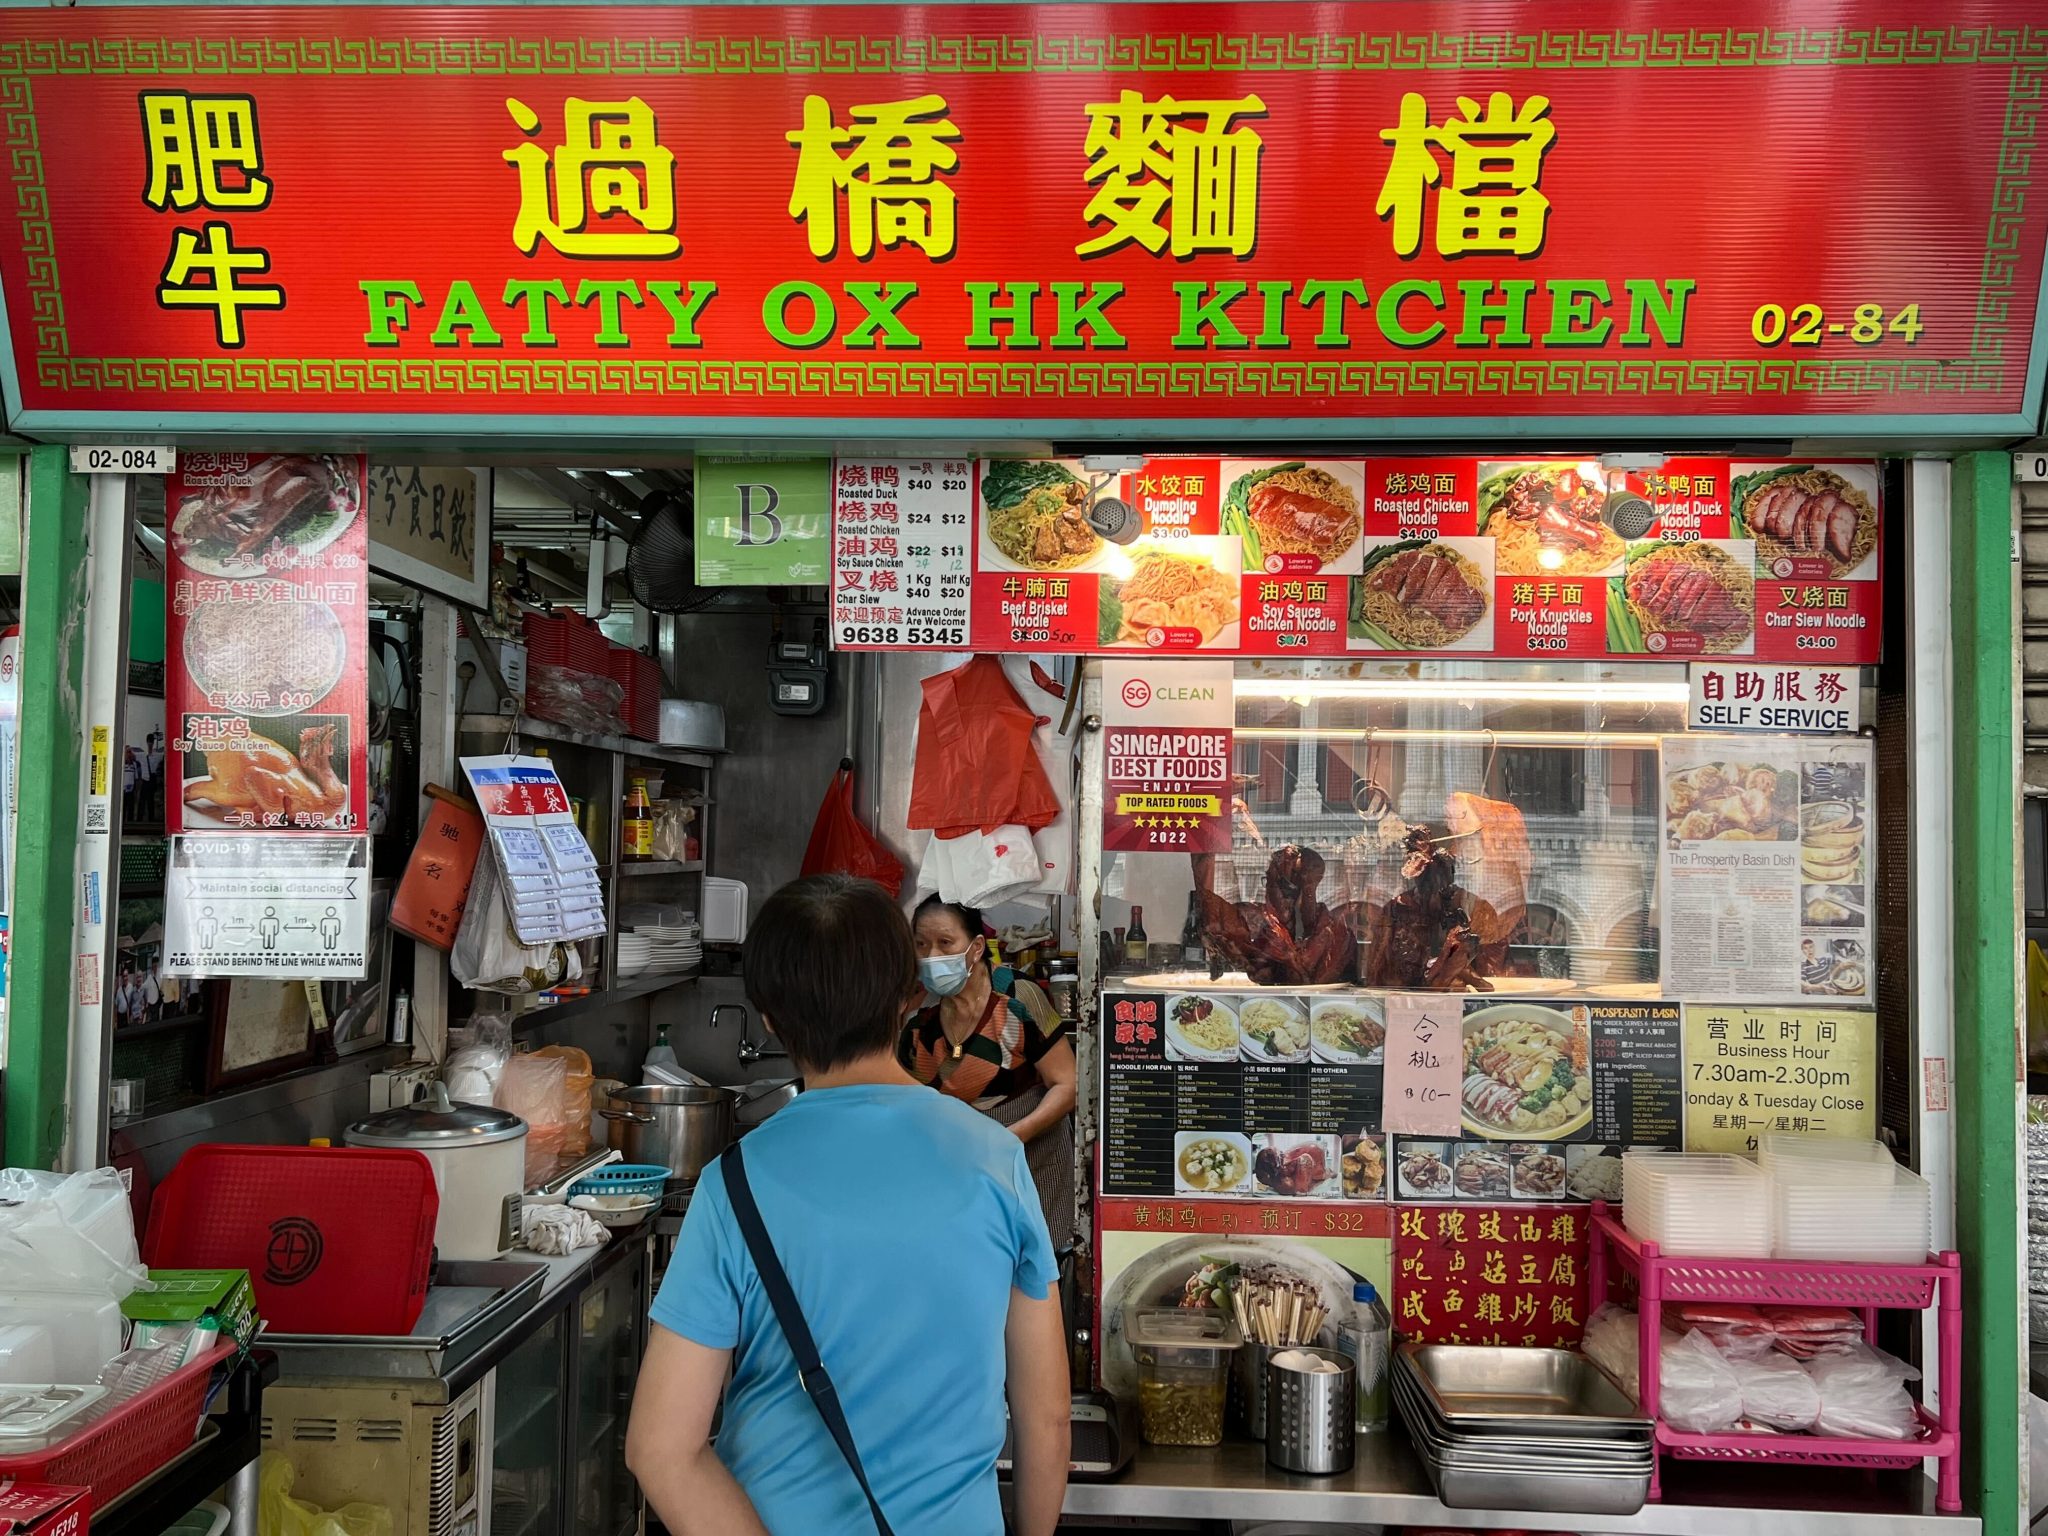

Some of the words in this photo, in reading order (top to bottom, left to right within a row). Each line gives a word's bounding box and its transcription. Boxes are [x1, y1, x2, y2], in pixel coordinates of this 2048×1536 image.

[502, 91, 1556, 260] 過橋麵檔
[140, 89, 284, 350] 肥牛
[358, 279, 718, 349] FATTY
[761, 281, 920, 349] OX
[964, 279, 1128, 349] HK
[1172, 278, 1697, 349] KITCHEN
[1750, 302, 1925, 347] 02-84
[88, 450, 157, 469] 02-084
[184, 475, 226, 487] Roasted
[229, 475, 254, 487] Duck
[838, 464, 900, 488] 烧鸭
[907, 480, 932, 491] $40
[942, 480, 967, 491] $20
[1137, 475, 1206, 497] 水饺面
[1385, 473, 1456, 495] 烧鸡面
[838, 488, 874, 500] Roasted
[875, 488, 898, 500] Duck
[838, 501, 899, 523] 烧鸡
[1144, 497, 1197, 515] Dumpling
[1374, 498, 1420, 513] Roasted
[1423, 498, 1469, 513] Chicken
[1693, 501, 1722, 516] Duck
[734, 483, 783, 547] B
[907, 513, 931, 525] $24
[942, 513, 966, 525] $12
[1151, 511, 1190, 525] Noodle
[1398, 511, 1438, 525] Noodle
[1659, 514, 1701, 529] Noodle
[837, 524, 868, 536] Roasted
[870, 524, 900, 536] Chicken
[1152, 527, 1189, 539] $3.00
[1400, 528, 1438, 540] $4.00
[1661, 530, 1700, 542] $5.00
[838, 535, 899, 558] 油鸡
[906, 546, 931, 557] $22
[263, 554, 289, 569] $40
[334, 555, 359, 569] $20
[837, 557, 851, 569] Soy
[852, 557, 874, 568] Sauce
[875, 557, 904, 569] Chicken
[837, 570, 899, 592] 叉烧
[915, 574, 931, 587] Kg
[941, 574, 958, 585] Half
[960, 574, 971, 587] Kg
[1002, 576, 1070, 600] 牛腩面
[906, 587, 930, 598] $40
[940, 587, 965, 598] $20
[1258, 580, 1328, 602] 油鸡面
[1512, 583, 1583, 605] 猪手面
[1778, 586, 1849, 608] 叉烧面
[836, 594, 858, 604] Char
[860, 594, 880, 604] Siew
[836, 606, 904, 625] 欢迎预定
[906, 607, 940, 617] Advance
[943, 607, 966, 617] Order
[1001, 600, 1028, 616] Beef
[1028, 600, 1068, 616] Brisket
[1262, 604, 1284, 619] Soy
[1287, 604, 1322, 618] Sauce
[1510, 608, 1537, 623] Pork
[1539, 608, 1593, 623] Knuckles
[906, 616, 922, 626] Are
[924, 616, 966, 626] Welcome
[1010, 613, 1050, 628] Noodle
[1249, 616, 1294, 631] Chicken
[1297, 616, 1337, 631] Noodle
[1765, 611, 1793, 627] Char
[1795, 611, 1823, 627] Siew
[1825, 612, 1866, 628] Noodle
[1527, 621, 1568, 635] Noodle
[843, 627, 899, 645] 9638
[907, 627, 963, 645] 5345
[1797, 636, 1836, 648] $4.00
[1528, 638, 1567, 650] $4.00
[1126, 688, 1147, 700] SG
[1156, 687, 1214, 700] CLEAN
[1701, 670, 1848, 703] 自助服務
[210, 692, 270, 708] 每公斤
[280, 692, 313, 708] $40
[1699, 705, 1752, 725] SELF
[1759, 707, 1849, 729] SERVICE
[187, 716, 251, 739] 油鸡
[173, 739, 193, 753] Soy
[196, 740, 226, 751] Sauce
[230, 740, 271, 752] Chicken
[1109, 733, 1226, 757] SINGAPORE
[1111, 758, 1158, 778] BEST
[1163, 759, 1222, 779] FOODS
[509, 777, 540, 785] FILTER
[541, 777, 559, 785] BAG
[1143, 782, 1192, 793] ENJOY
[1126, 797, 1143, 807] TOP
[1146, 797, 1175, 808] RATED
[1177, 798, 1208, 809] FOODS
[224, 813, 255, 828] 一只
[295, 813, 326, 828] 半只
[1149, 831, 1187, 844] 2022
[183, 842, 250, 855] COVID-19
[1669, 853, 1689, 865] The
[1743, 854, 1770, 866] Basin
[1773, 855, 1795, 867] Dish
[199, 882, 247, 894] Maintain
[249, 882, 283, 893] social
[285, 882, 344, 895] distancing
[169, 957, 202, 967] PLEASE
[203, 957, 230, 967] STAND
[231, 957, 264, 967] BEHIND
[264, 957, 280, 967] THE
[281, 957, 300, 967] LINE
[301, 957, 325, 967] WHILE
[326, 957, 363, 968] WAITING
[1707, 1018, 1838, 1043] 营业时间
[1717, 1043, 1787, 1059] Business
[1792, 1045, 1830, 1060] Hour
[1692, 1063, 1851, 1090] 7.30am-2.30pm
[1686, 1092, 1734, 1110] onday
[1738, 1094, 1750, 1108] &
[1754, 1094, 1816, 1112] Tuesday
[1821, 1095, 1865, 1111] Close
[1712, 1114, 1827, 1132] 星期一/星期二
[1260, 1209, 1303, 1231] 预订
[1324, 1212, 1364, 1232] $32
